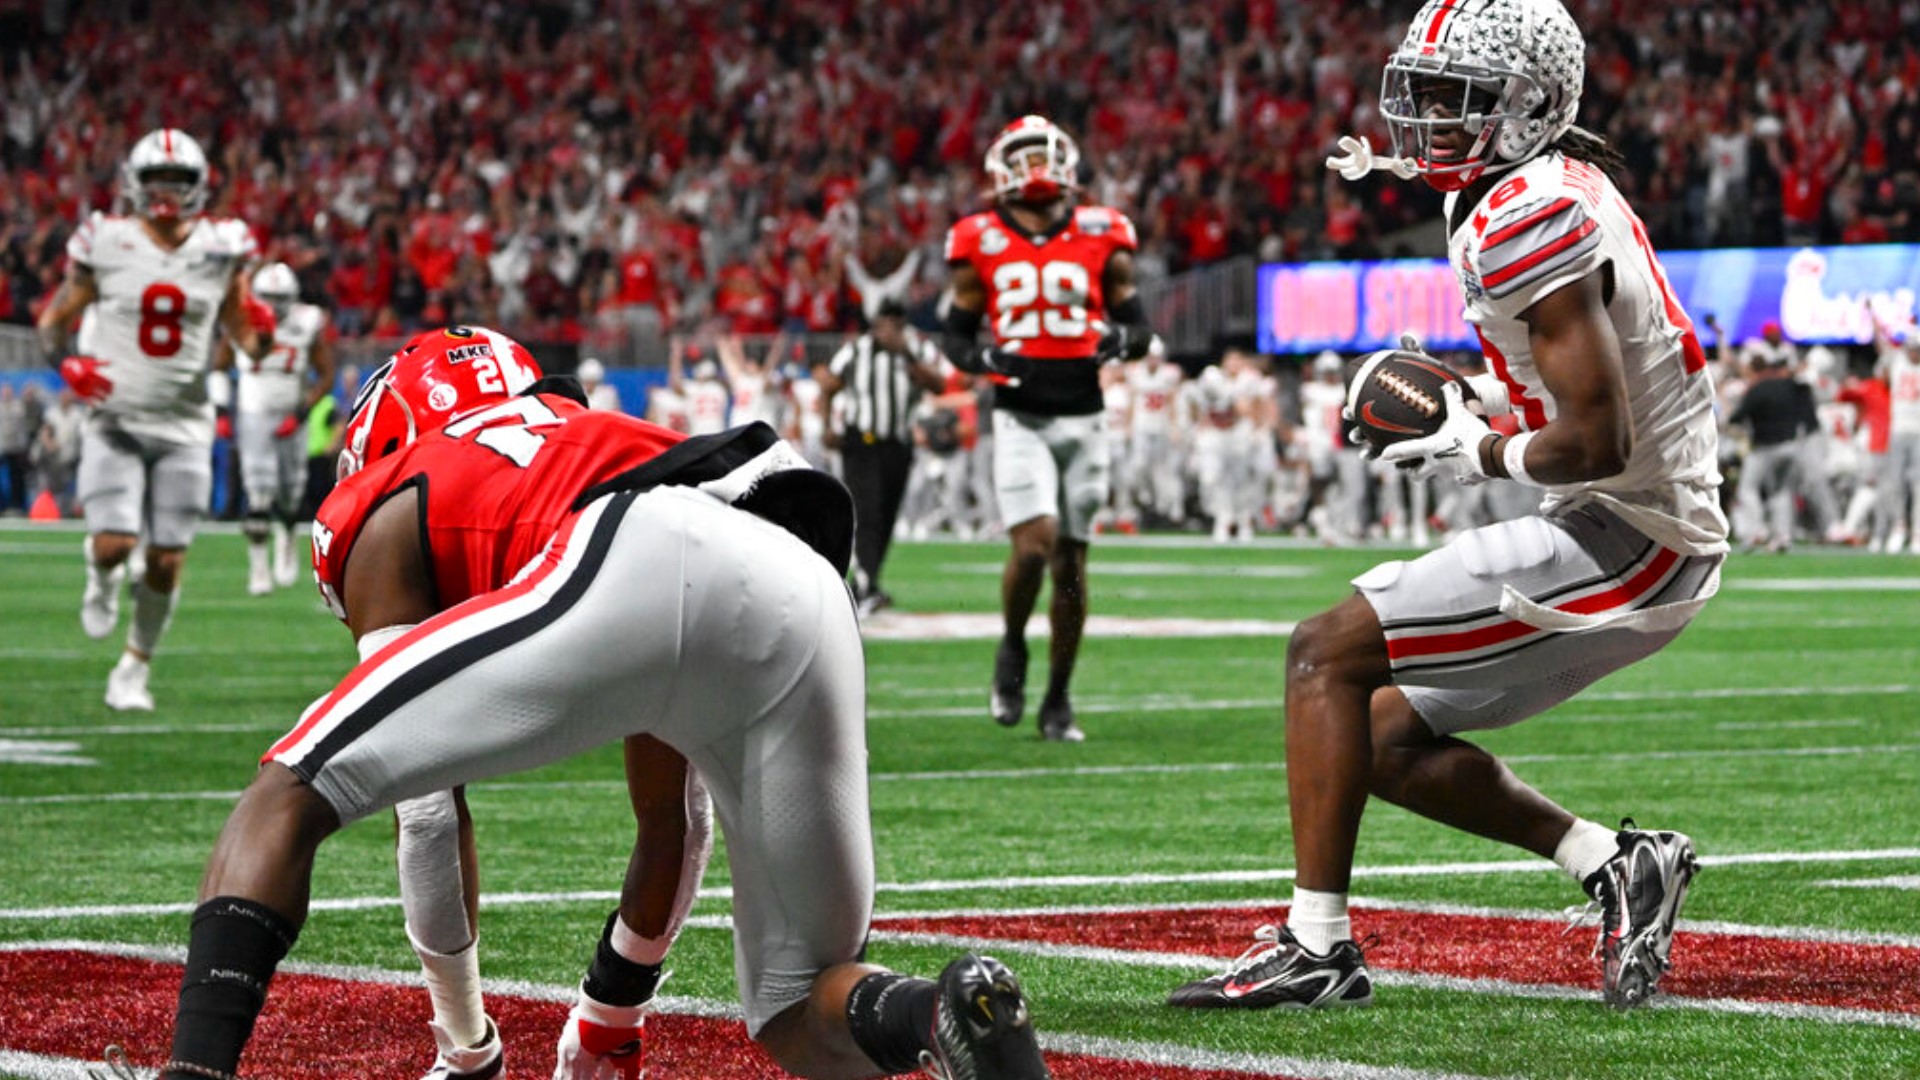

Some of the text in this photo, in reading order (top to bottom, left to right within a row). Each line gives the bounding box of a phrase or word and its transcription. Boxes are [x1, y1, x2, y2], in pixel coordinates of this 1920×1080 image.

[138, 283, 187, 358] 8
[992, 260, 1090, 338] 29
[471, 358, 505, 393] 2
